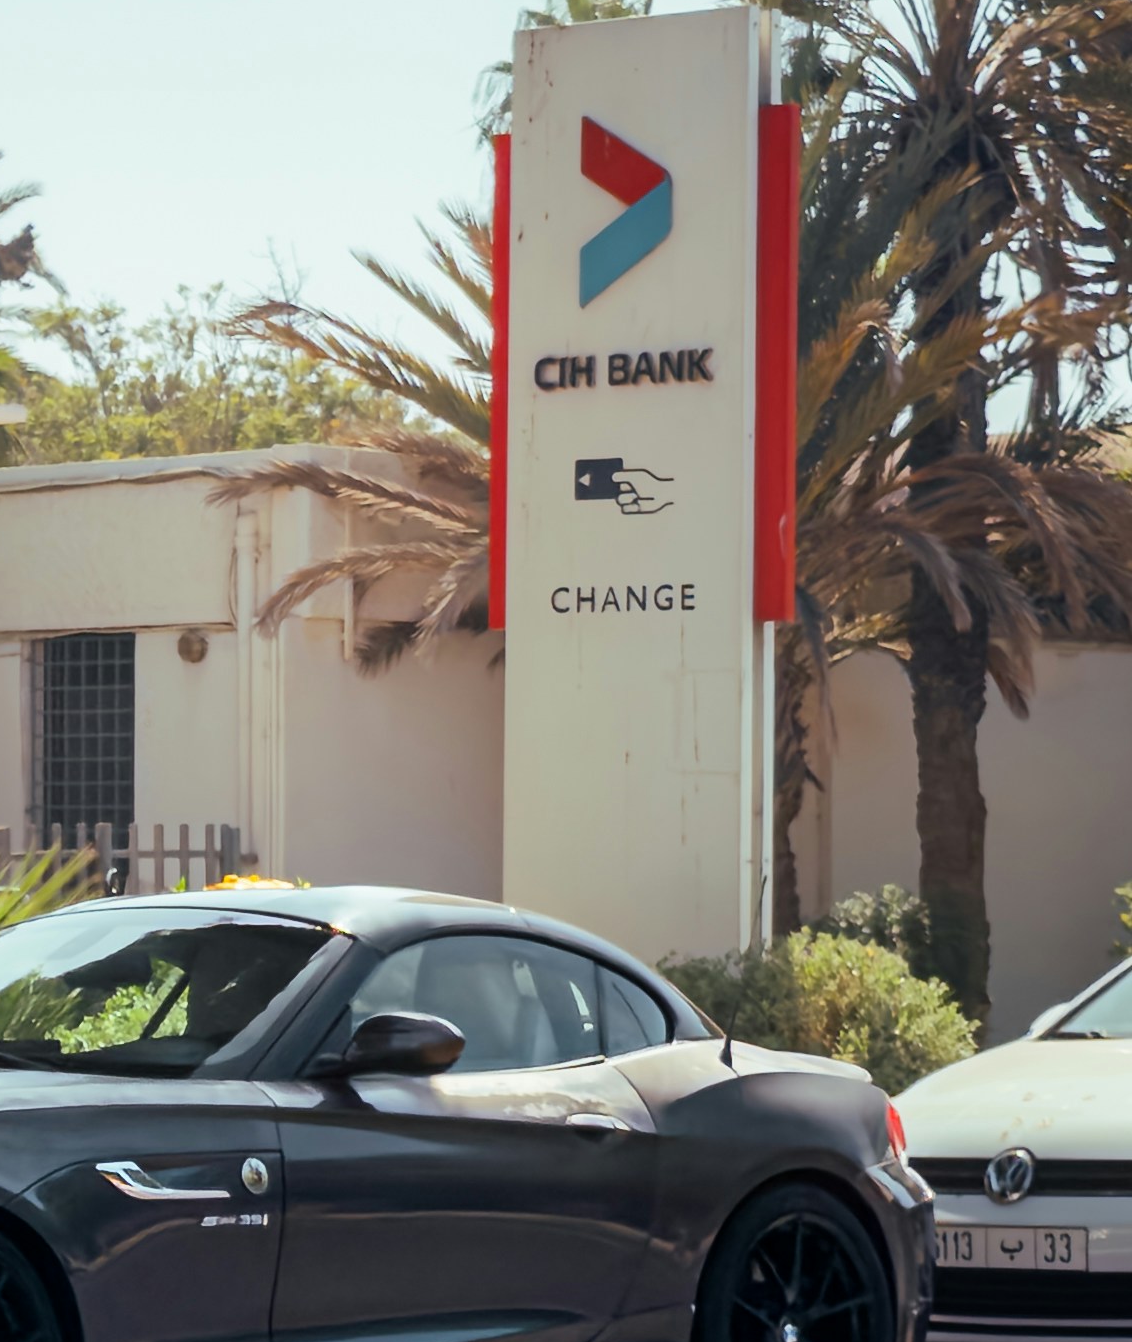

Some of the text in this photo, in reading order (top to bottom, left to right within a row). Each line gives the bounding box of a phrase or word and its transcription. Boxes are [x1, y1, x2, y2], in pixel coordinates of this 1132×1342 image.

[534, 348, 714, 390] CIH BANK
[551, 584, 696, 613] CHANGE
[1000, 1237, 1024, 1261] ب
[1044, 1232, 1072, 1264] 33
